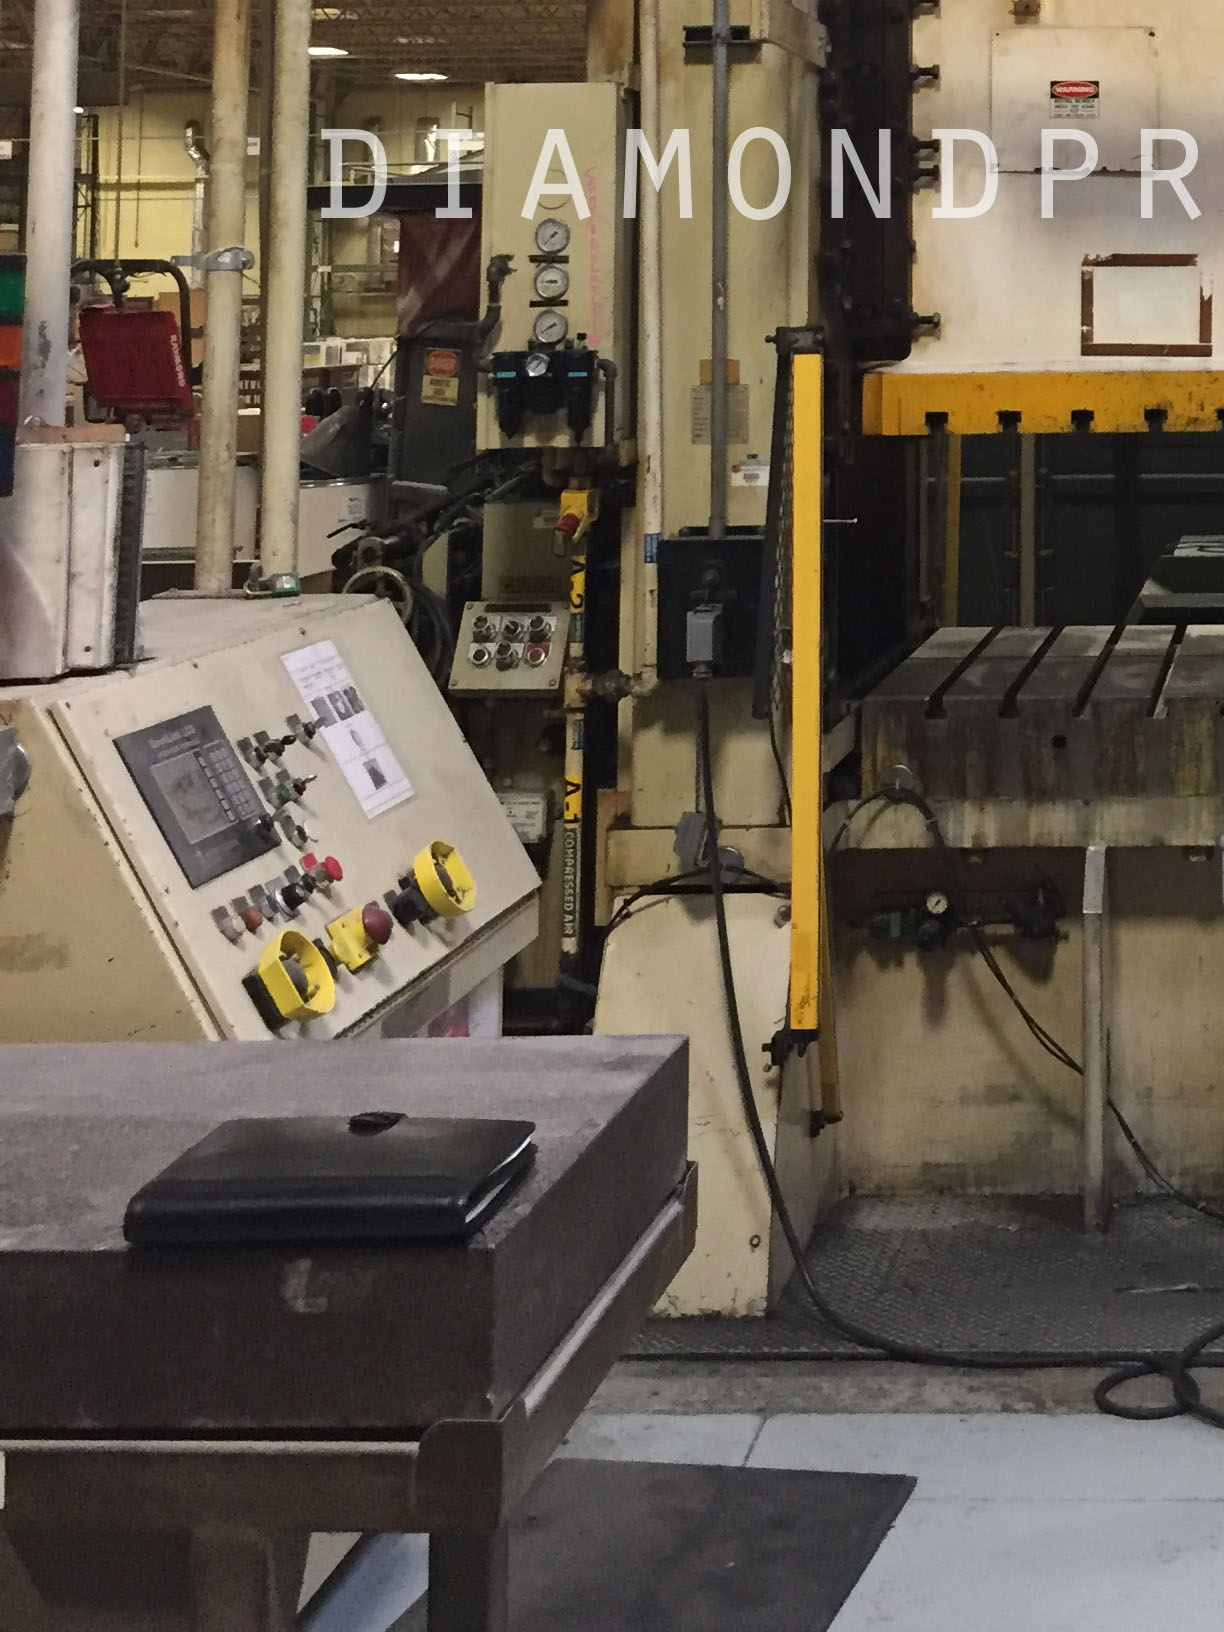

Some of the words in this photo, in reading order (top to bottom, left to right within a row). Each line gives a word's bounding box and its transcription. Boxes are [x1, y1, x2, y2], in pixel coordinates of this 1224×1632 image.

[170, 334, 186, 387] RAYMOND
[565, 778, 581, 824] A-1
[564, 831, 575, 911] COMPRESSED
[563, 914, 574, 935] AIR
